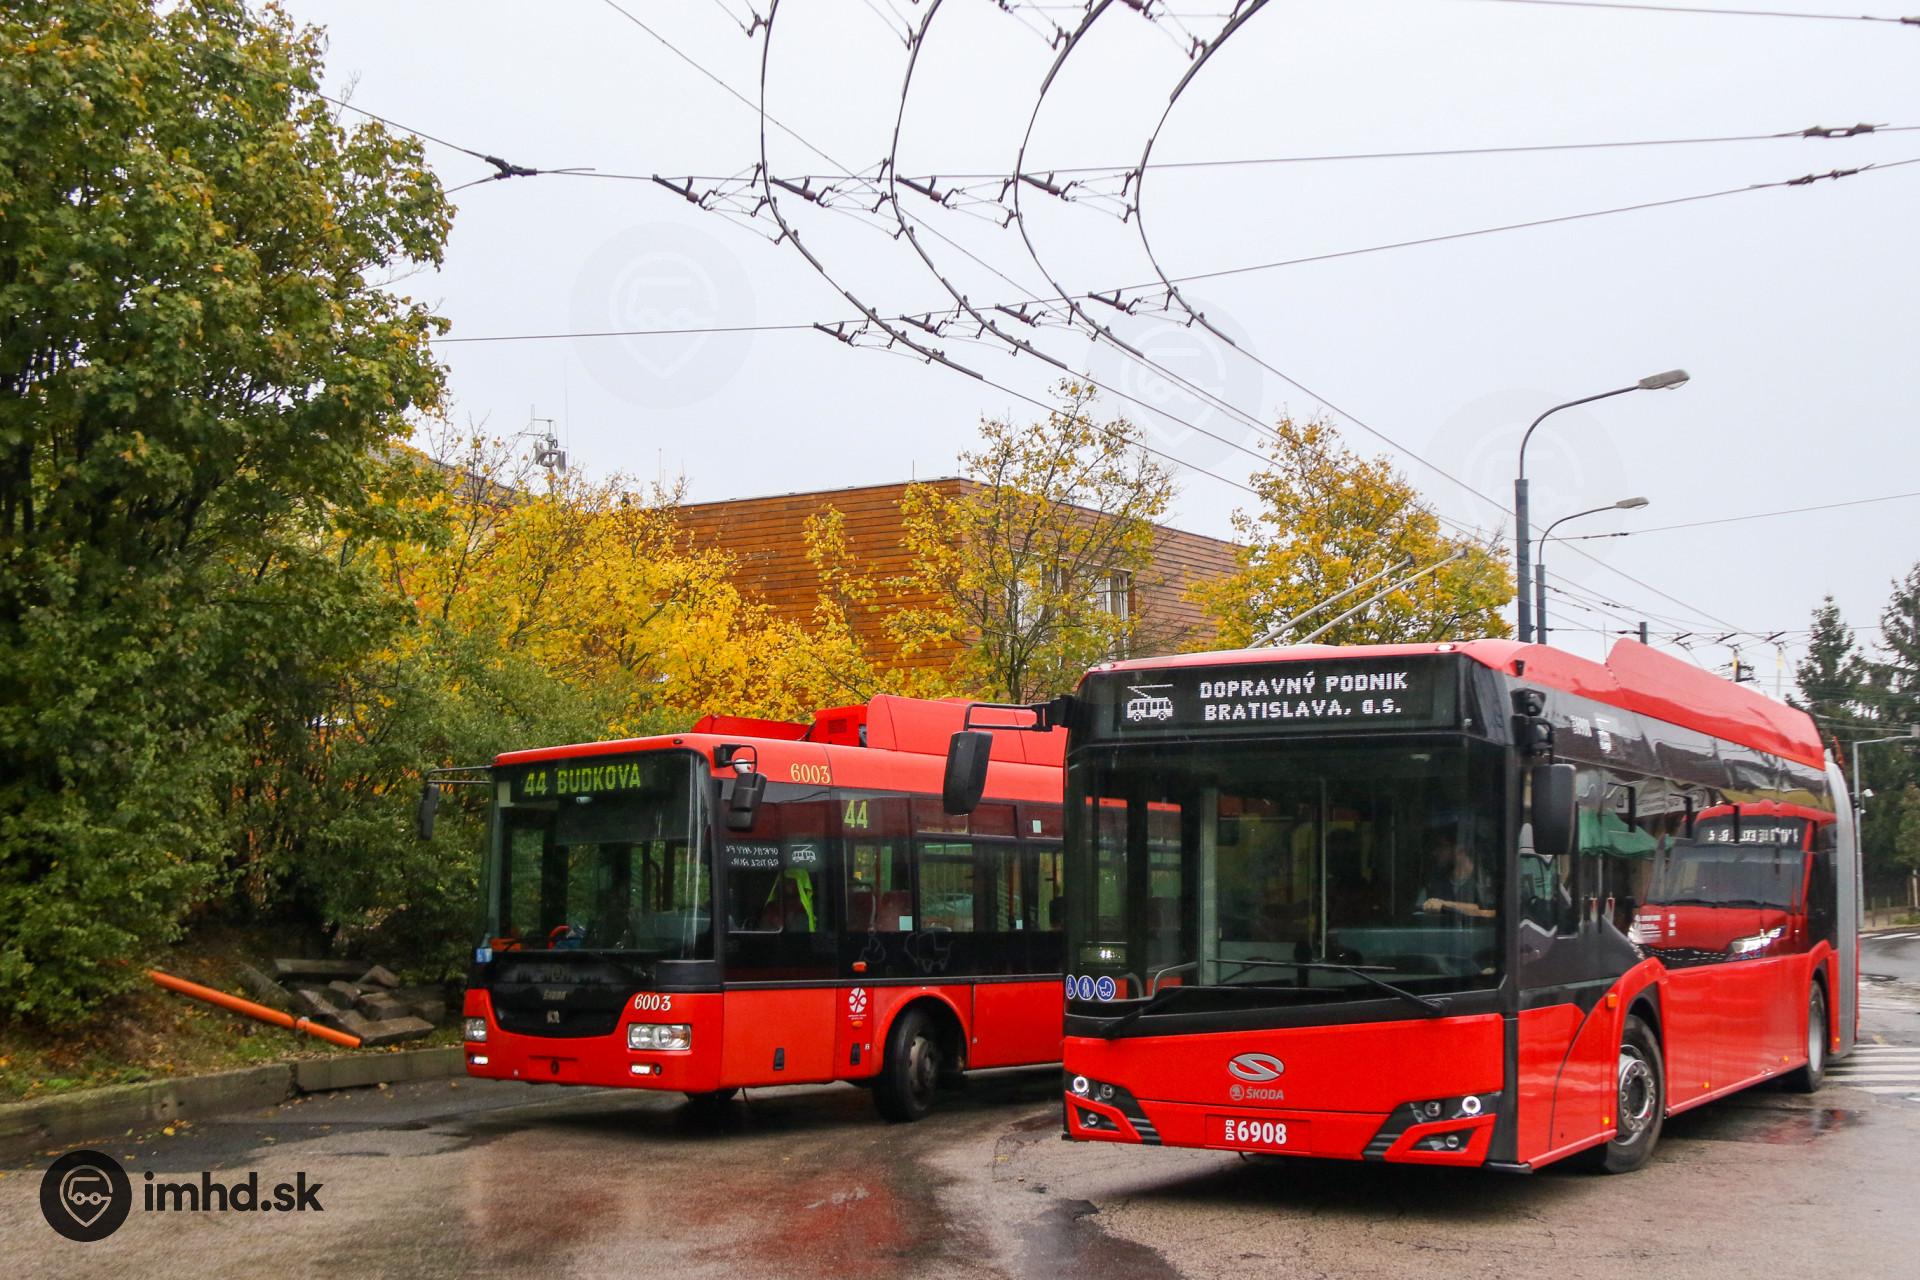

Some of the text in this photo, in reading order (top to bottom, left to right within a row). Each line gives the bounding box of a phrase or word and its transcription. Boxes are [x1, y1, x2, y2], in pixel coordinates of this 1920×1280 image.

[1200, 670, 1409, 699] DOPRAVNÝ PODNIK
[1204, 700, 1352, 721] BRATISLAVA,
[524, 763, 641, 796] 44 BUDKOVA
[790, 763, 832, 784] 6003
[843, 800, 868, 829] 44
[634, 993, 672, 1012] 6003
[1246, 1086, 1284, 1100] ŠKODA
[1225, 1119, 1235, 1141] DPB
[1237, 1120, 1287, 1145] 6908
